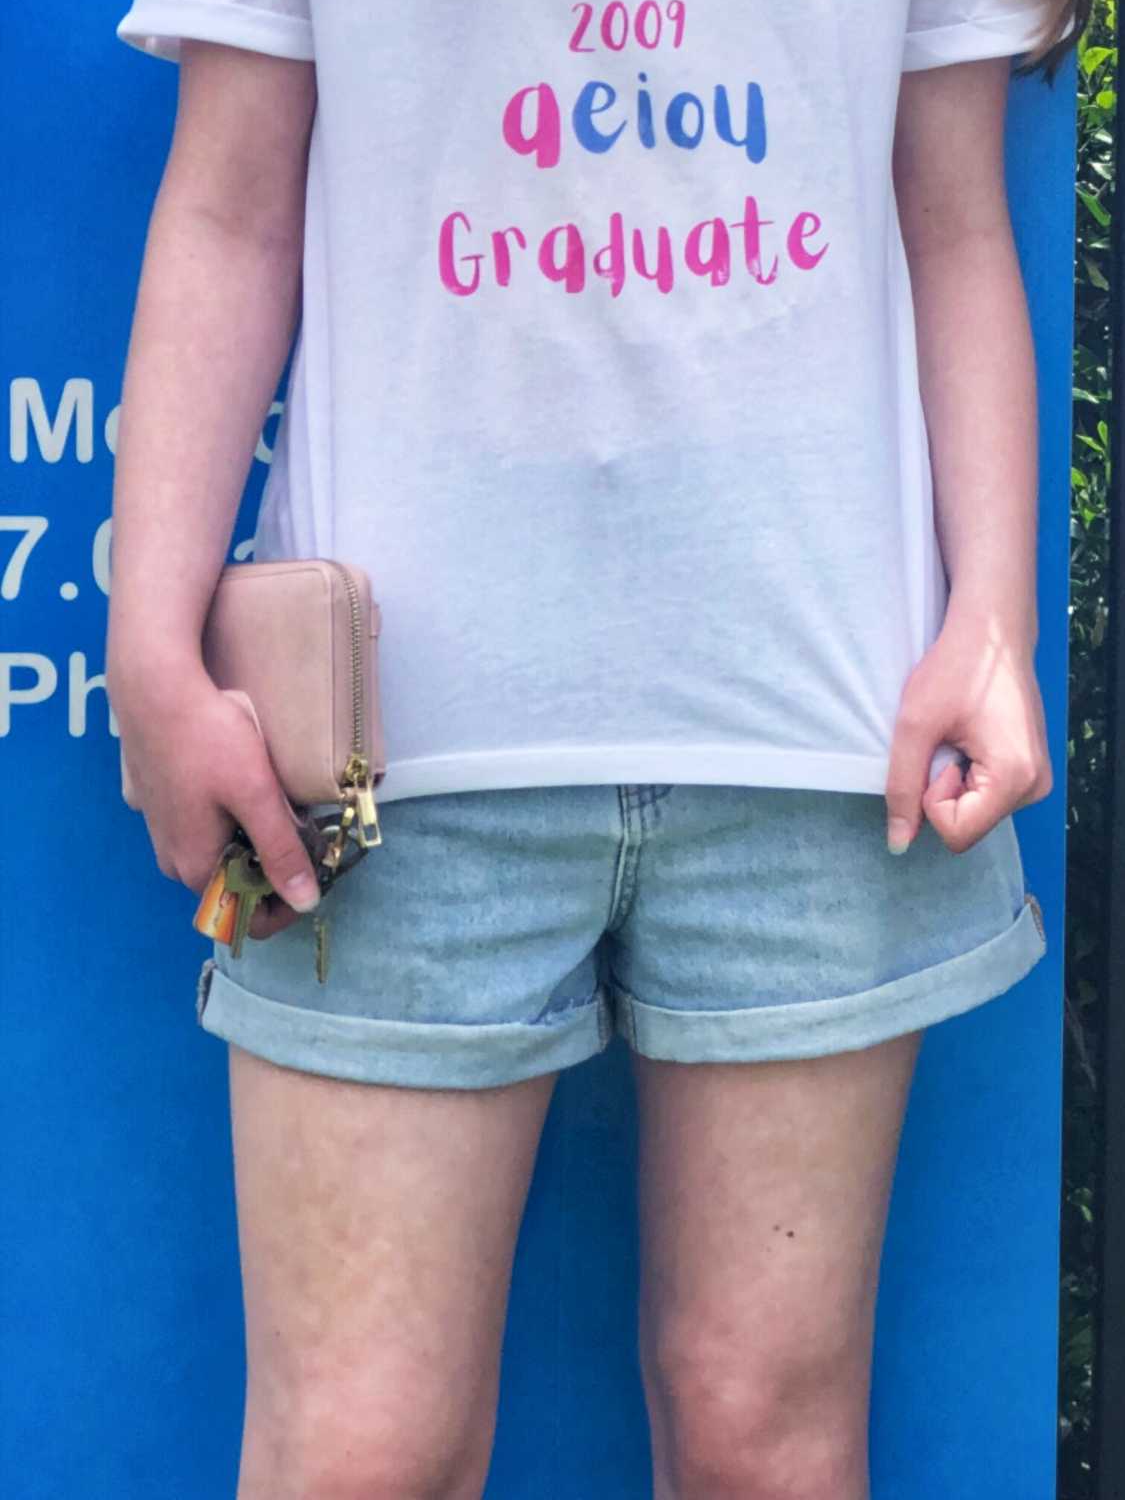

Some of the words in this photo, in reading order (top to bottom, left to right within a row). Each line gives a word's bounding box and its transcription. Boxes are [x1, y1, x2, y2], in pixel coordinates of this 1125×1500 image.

[568, 0, 686, 53] 2009
[502, 71, 767, 169] aeiou
[438, 195, 830, 298] Graduate
